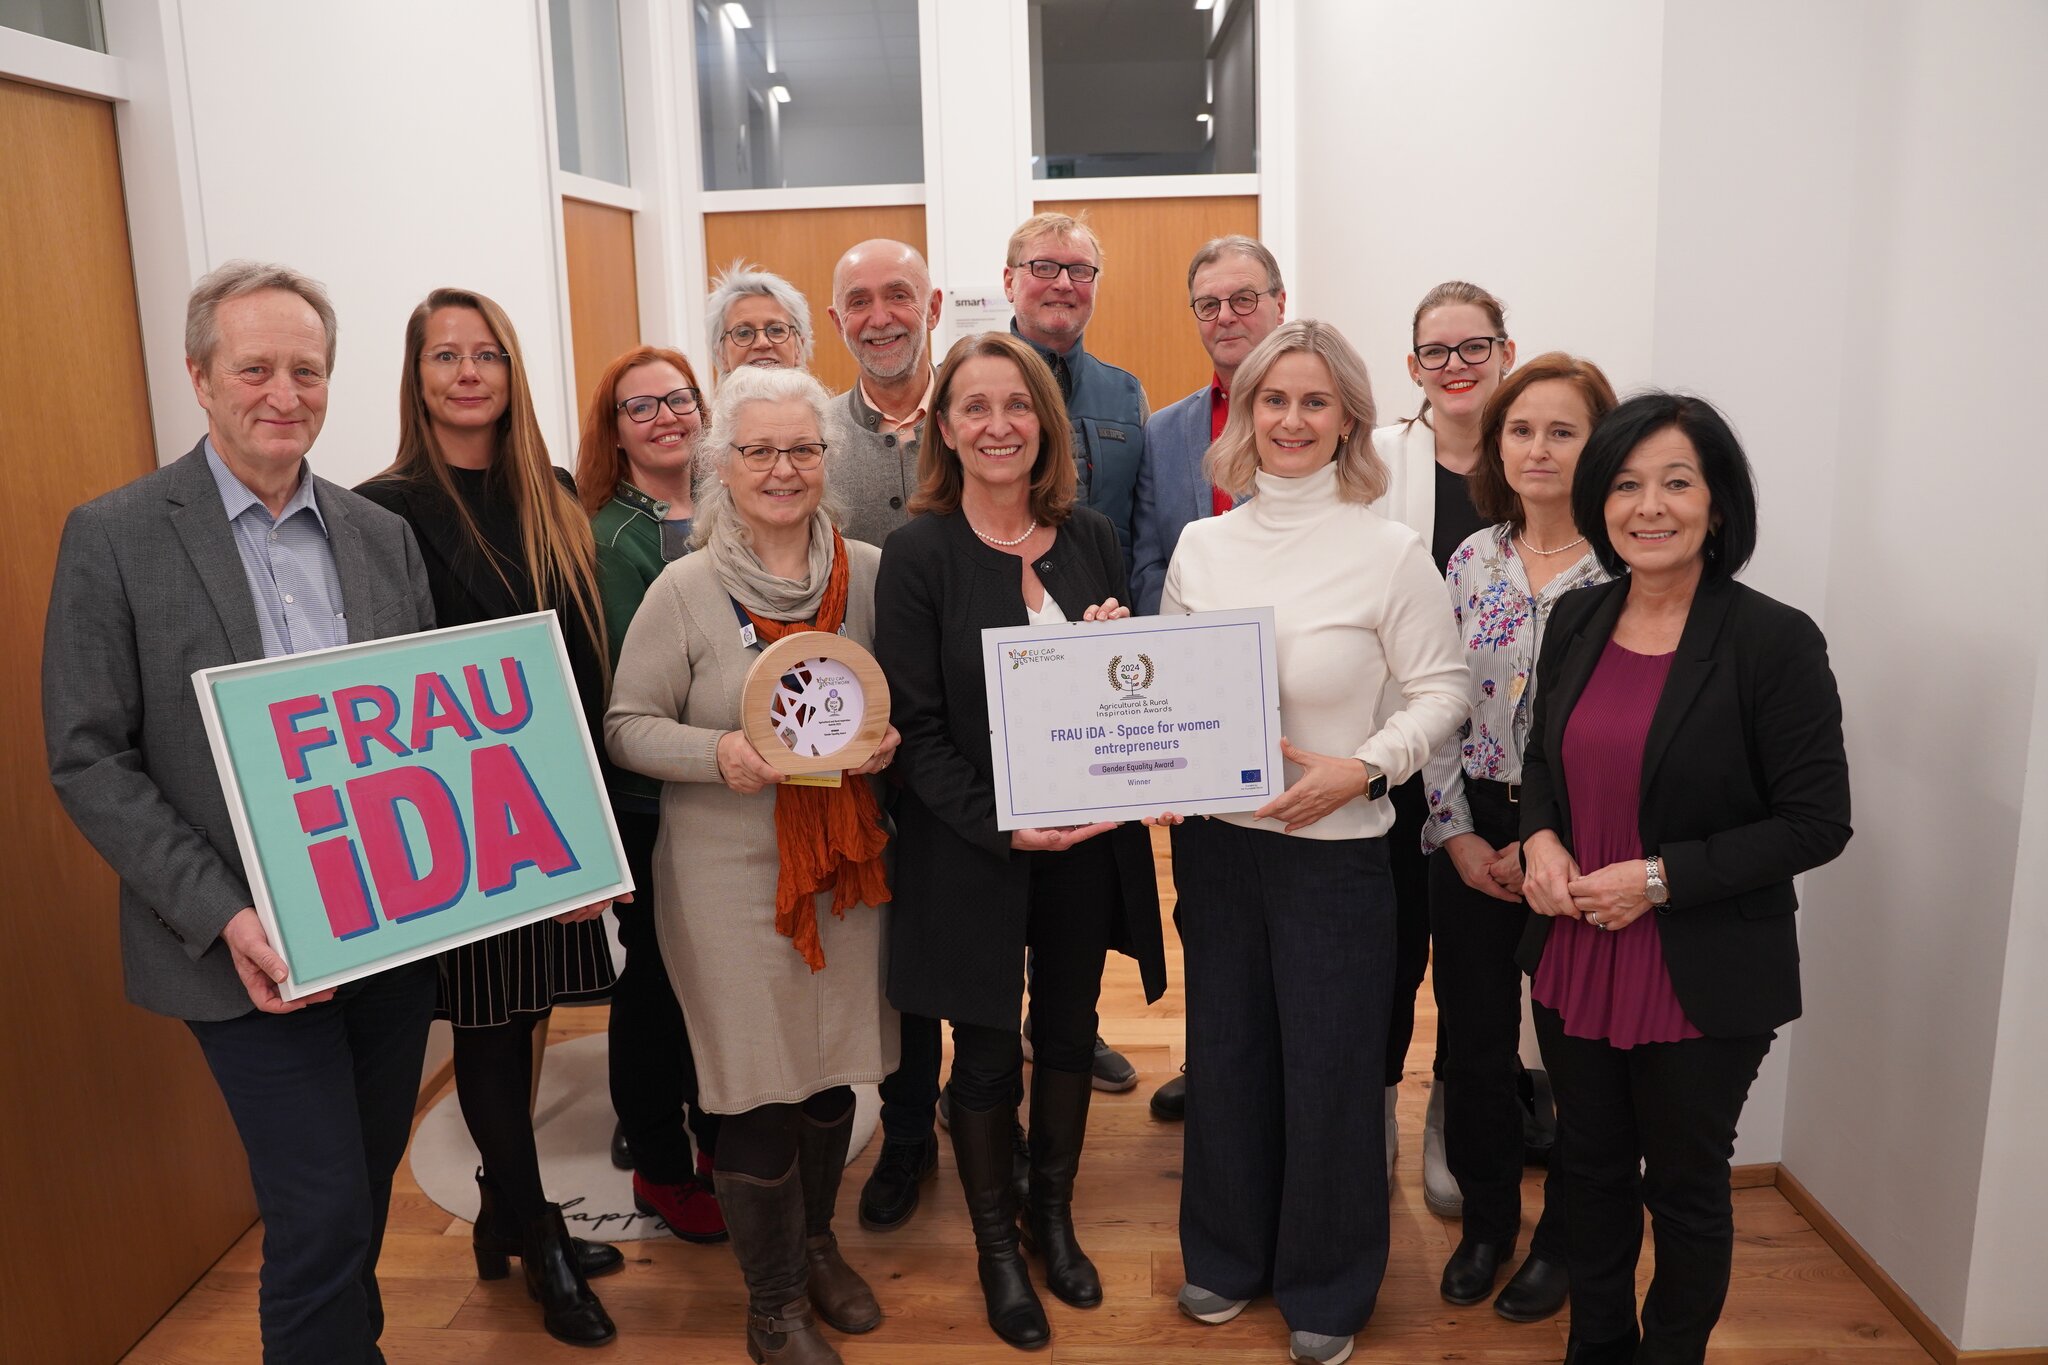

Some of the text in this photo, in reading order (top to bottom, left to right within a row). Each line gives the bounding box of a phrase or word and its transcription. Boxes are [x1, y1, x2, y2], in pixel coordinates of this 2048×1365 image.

[955, 298, 985, 307] smart
[1121, 664, 1140, 672] 2024
[1096, 706, 1173, 718] Inspiration Awards
[1099, 701, 1141, 711] Agricultural
[268, 656, 533, 783] FRAU
[1050, 727, 1083, 742] FRAU
[1086, 726, 1106, 740] iDA
[1117, 724, 1154, 739] Space
[1157, 720, 1175, 734] for
[1177, 719, 1220, 733] women
[1094, 739, 1180, 756] entrepreneurs
[1102, 760, 1175, 773] Gender Equality Award
[293, 743, 582, 942] iDA
